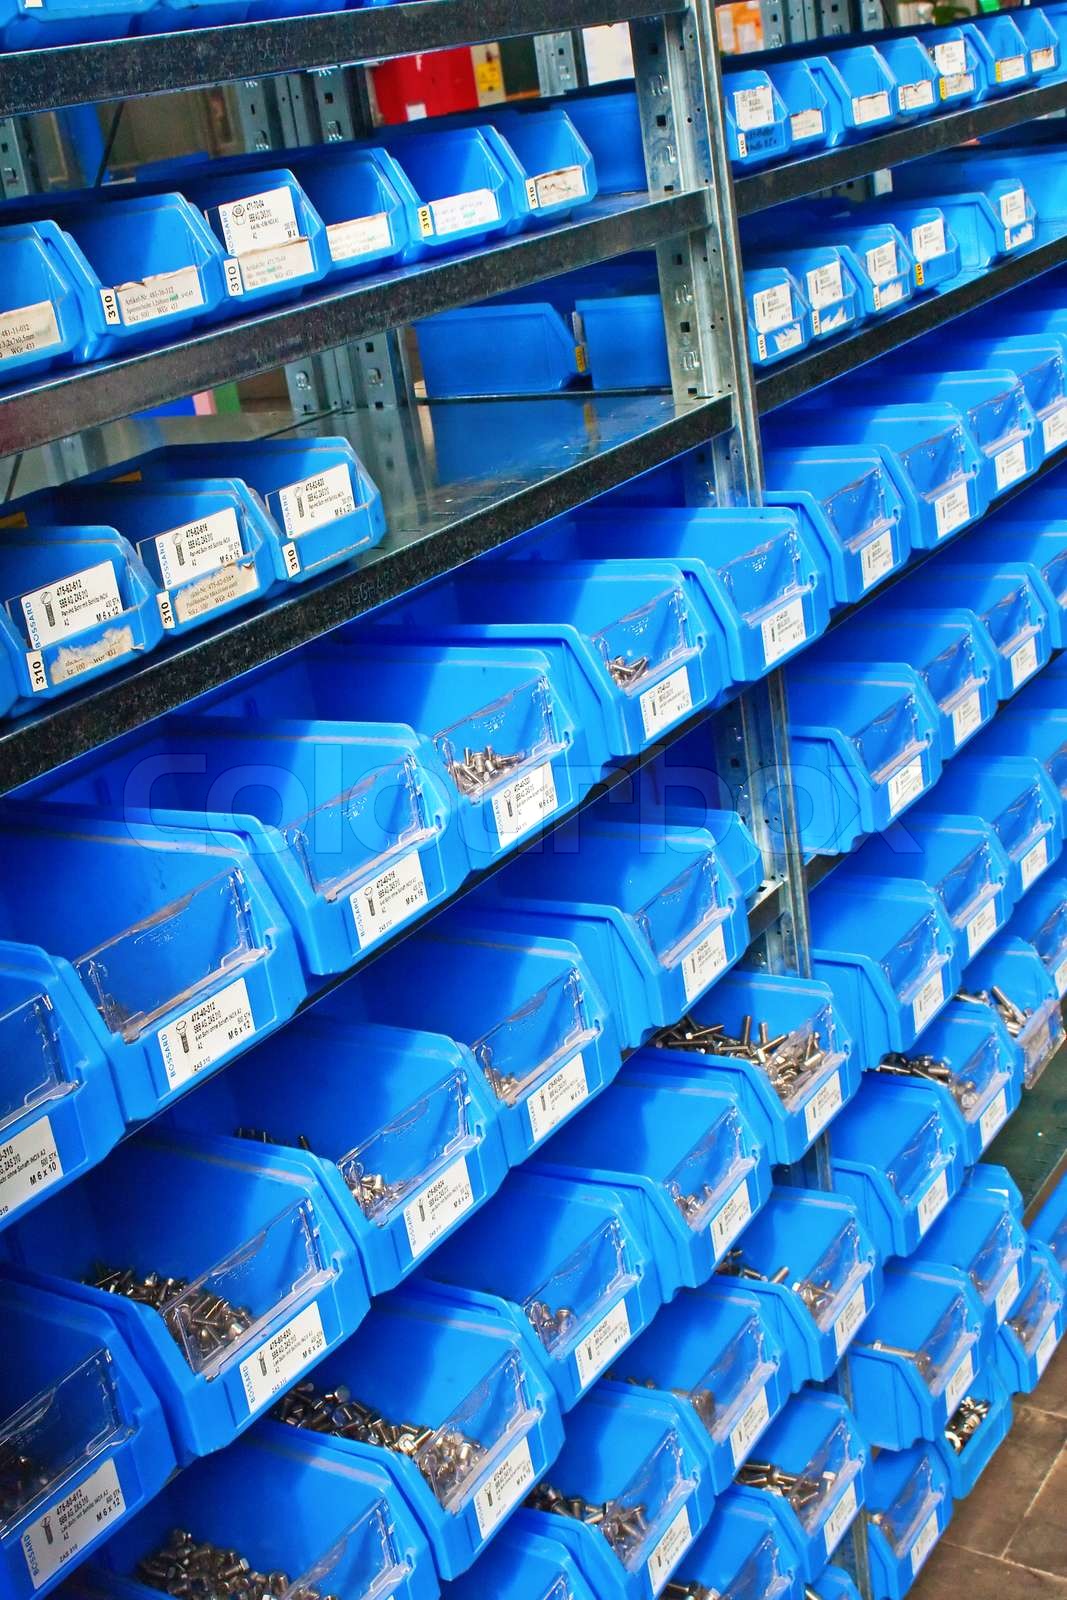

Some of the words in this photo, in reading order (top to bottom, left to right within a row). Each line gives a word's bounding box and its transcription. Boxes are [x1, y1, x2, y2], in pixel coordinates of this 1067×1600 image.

[420, 210, 430, 230] 310
[228, 266, 240, 292] 310
[105, 295, 116, 318] 310
[159, 542, 172, 586] BOSSARD
[287, 549, 298, 570] 310
[56, 579, 82, 597] 475-62-612
[96, 613, 102, 623] M
[112, 607, 120, 616] 12
[161, 601, 172, 624] 310
[25, 601, 41, 649] BOSSARD
[32, 661, 45, 685] 310
[191, 1002, 216, 1022] 472-40-312
[228, 1030, 234, 1040] M
[243, 1020, 251, 1030] 12
[161, 1034, 176, 1078] BOSSARD
[30, 1174, 37, 1186] M
[49, 1161, 57, 1172] 10
[96, 1512, 102, 1523] M
[113, 1497, 121, 1508] 12
[24, 1535, 40, 1576] BOSSARD
